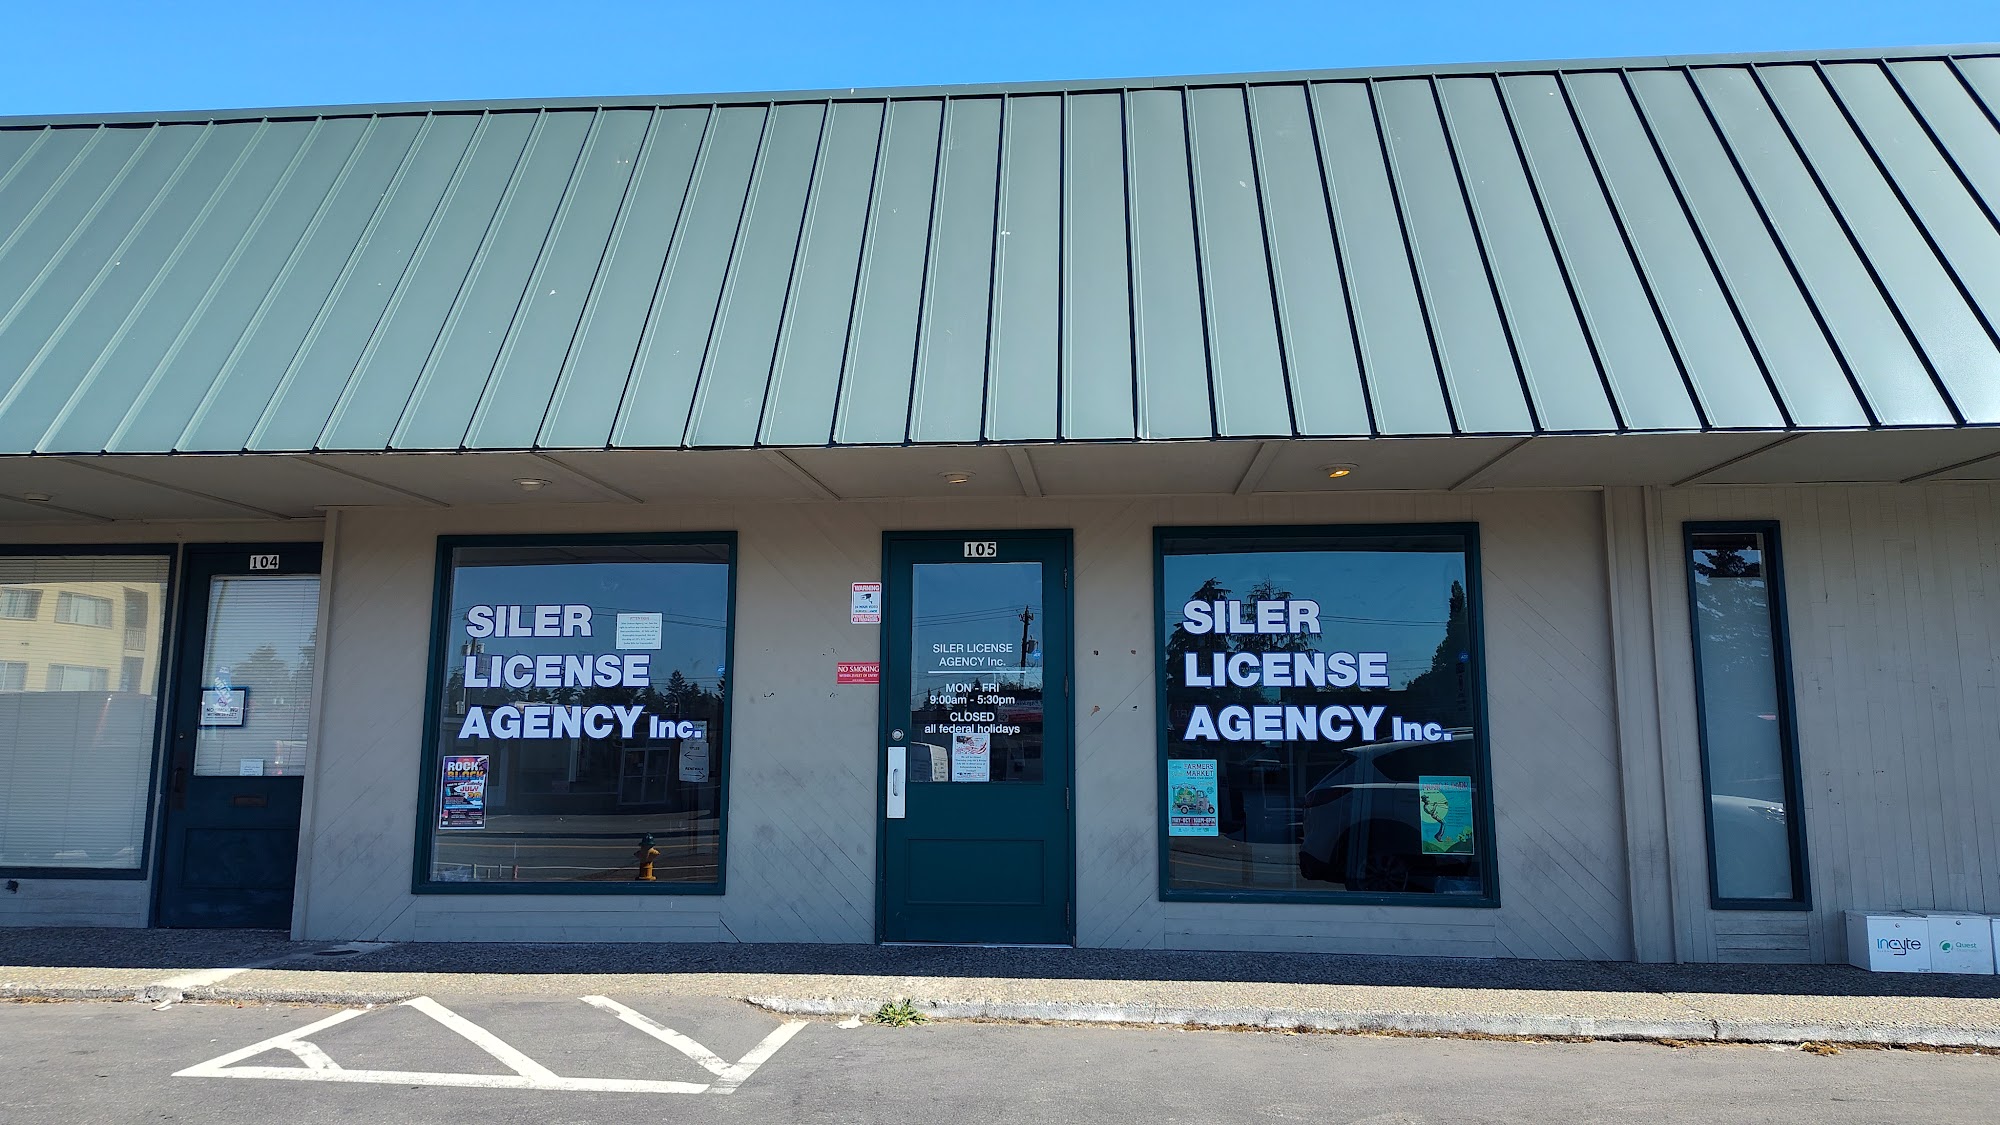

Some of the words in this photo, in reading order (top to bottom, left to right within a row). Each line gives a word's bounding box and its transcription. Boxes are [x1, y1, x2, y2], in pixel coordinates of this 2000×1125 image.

[966, 543, 996, 557] 105
[252, 555, 278, 569] 104
[466, 604, 594, 638] SILER
[1182, 599, 1322, 635] SILER
[932, 643, 964, 653] SILER
[967, 643, 1013, 653] LICENSE
[939, 657, 985, 667] AGENCY
[988, 657, 1006, 667] Inc.
[464, 654, 650, 688] LICENSE
[1184, 652, 1390, 687] LICENSE
[945, 683, 972, 693] MON
[982, 683, 1000, 693] FRI
[930, 695, 967, 705] 9:00am
[977, 695, 1016, 707] 5:30pm
[458, 705, 646, 740] AGENCY
[650, 715, 703, 740] Inc.
[949, 712, 995, 722] CLOSED
[1183, 705, 1387, 741] AGENCY
[1391, 715, 1452, 741] Inc.
[924, 724, 936, 734] all
[939, 724, 975, 734] federal
[978, 724, 1021, 736] holidays
[448, 761, 479, 771] ROCK
[447, 771, 484, 781] BLOCK
